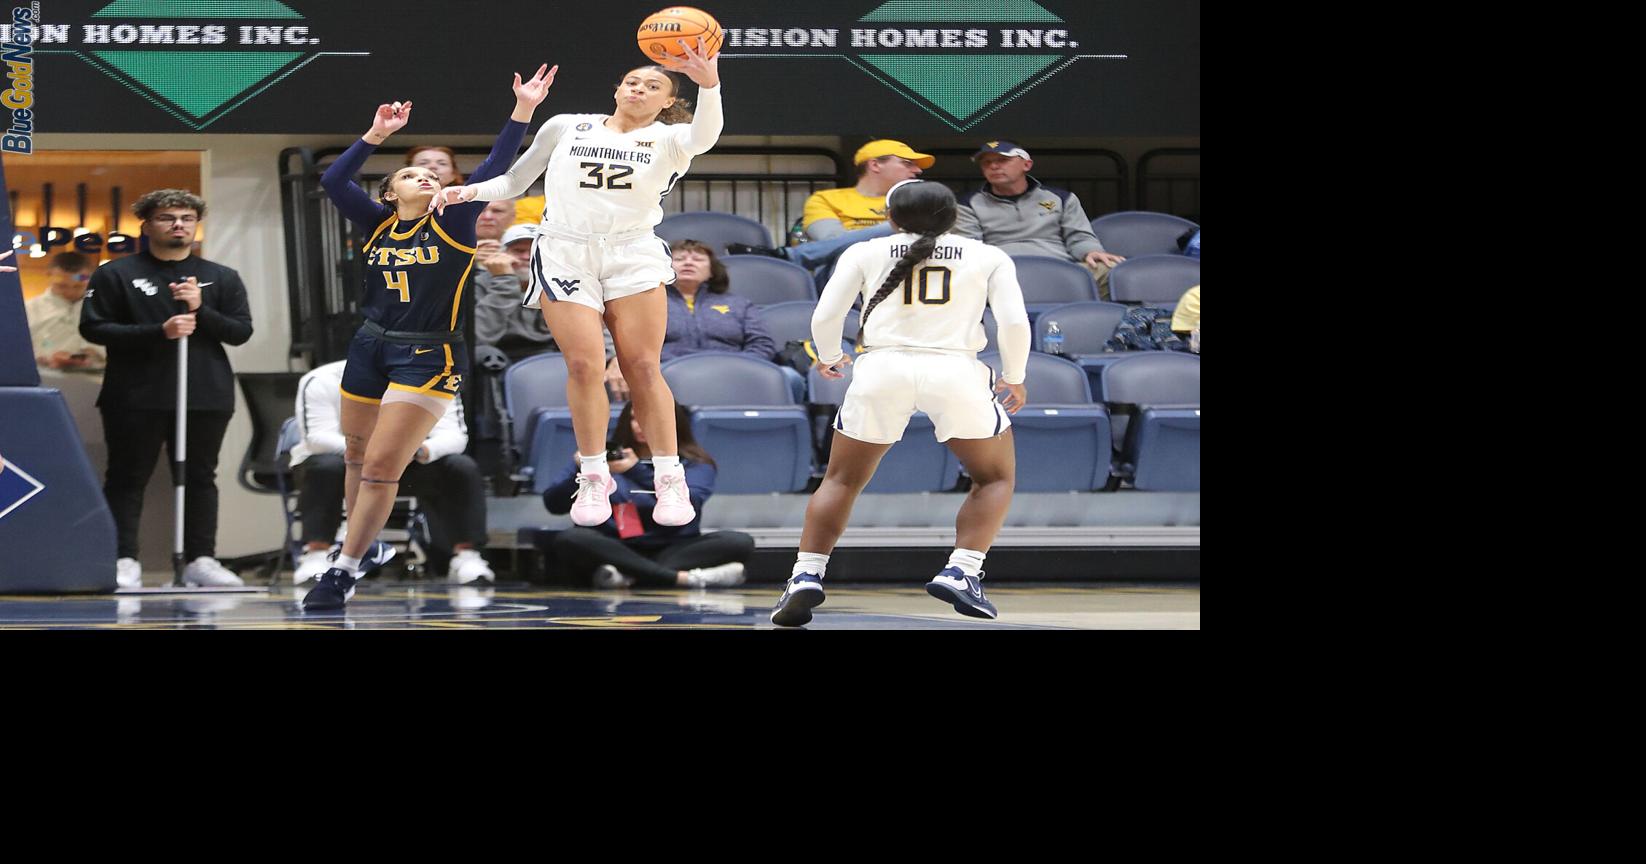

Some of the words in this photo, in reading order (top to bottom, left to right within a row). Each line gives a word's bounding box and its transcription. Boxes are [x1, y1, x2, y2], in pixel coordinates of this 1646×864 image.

[82, 25, 227, 44] HOMES
[239, 26, 320, 45] INC.
[850, 29, 988, 48] HOMES
[1000, 29, 1079, 48] INC.
[569, 145, 652, 164] MOUNTAINEERS
[579, 162, 634, 189] 32
[890, 244, 963, 260] HASON
[382, 271, 410, 303] 4
[903, 266, 951, 305] 10
